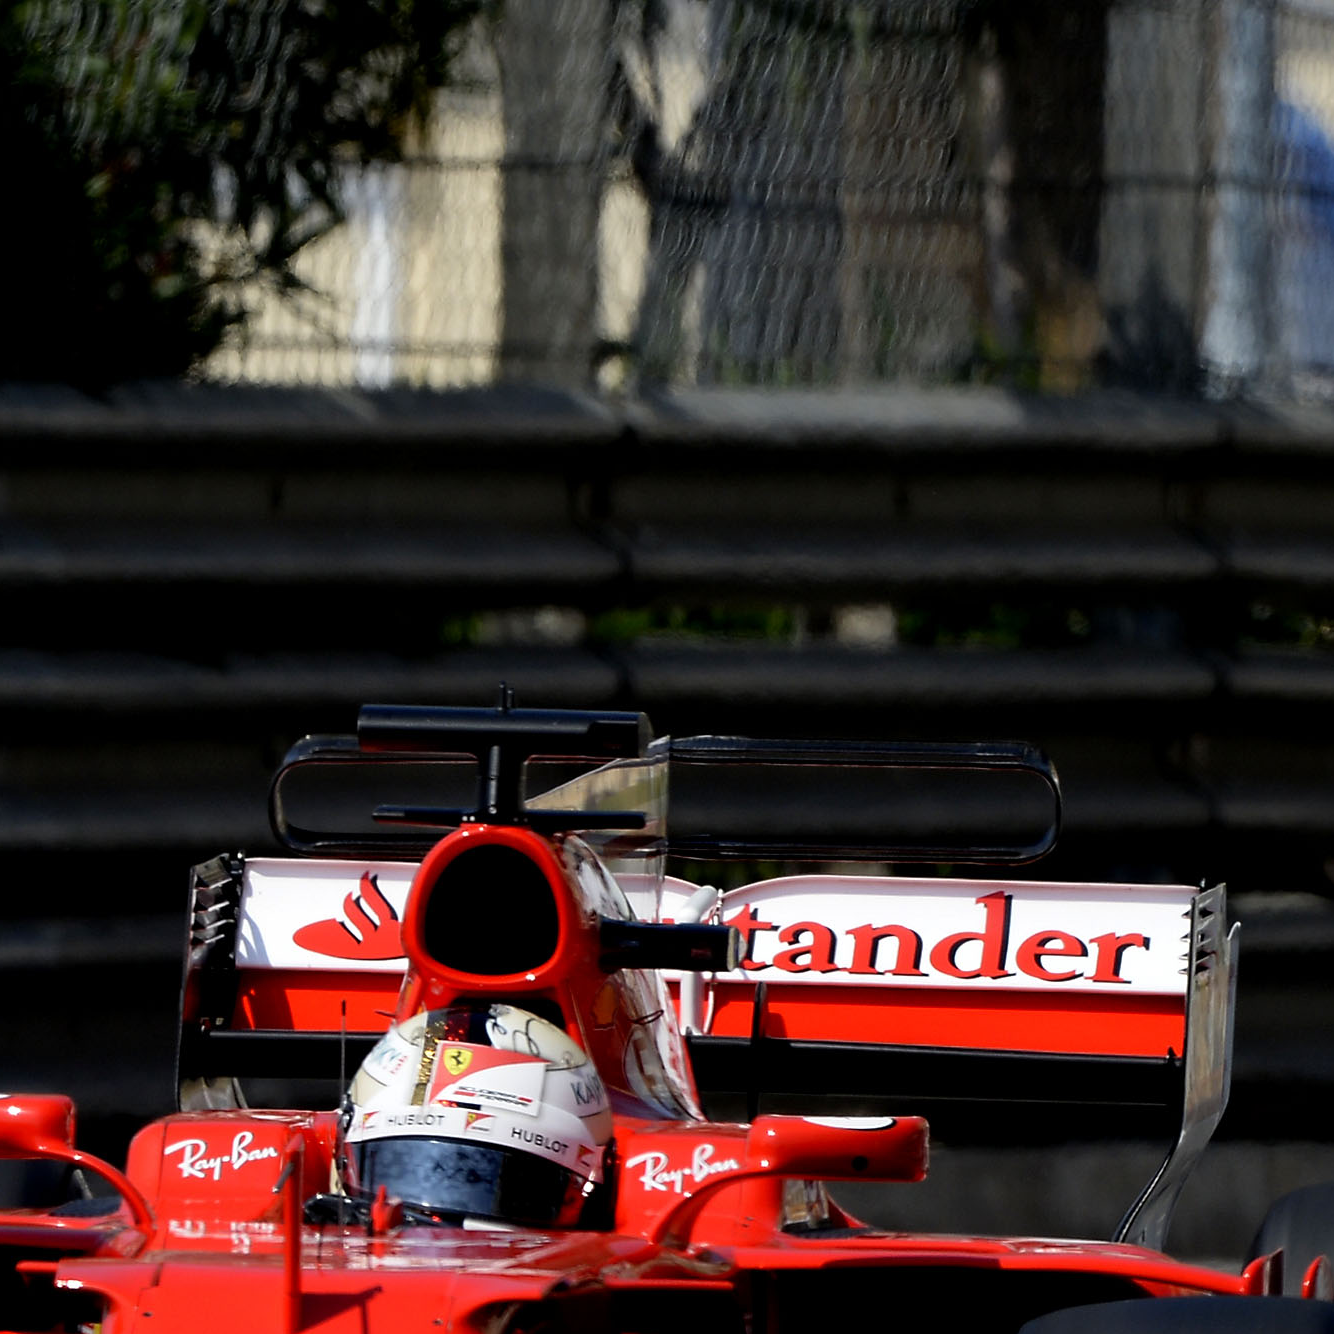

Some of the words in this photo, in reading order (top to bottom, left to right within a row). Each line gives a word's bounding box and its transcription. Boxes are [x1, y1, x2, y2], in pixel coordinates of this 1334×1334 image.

[703, 890, 1151, 984] tander
[164, 1131, 278, 1181] Ray-Ban
[511, 1126, 569, 1154] HUBLOT
[625, 1143, 740, 1194] Ray-Ban
